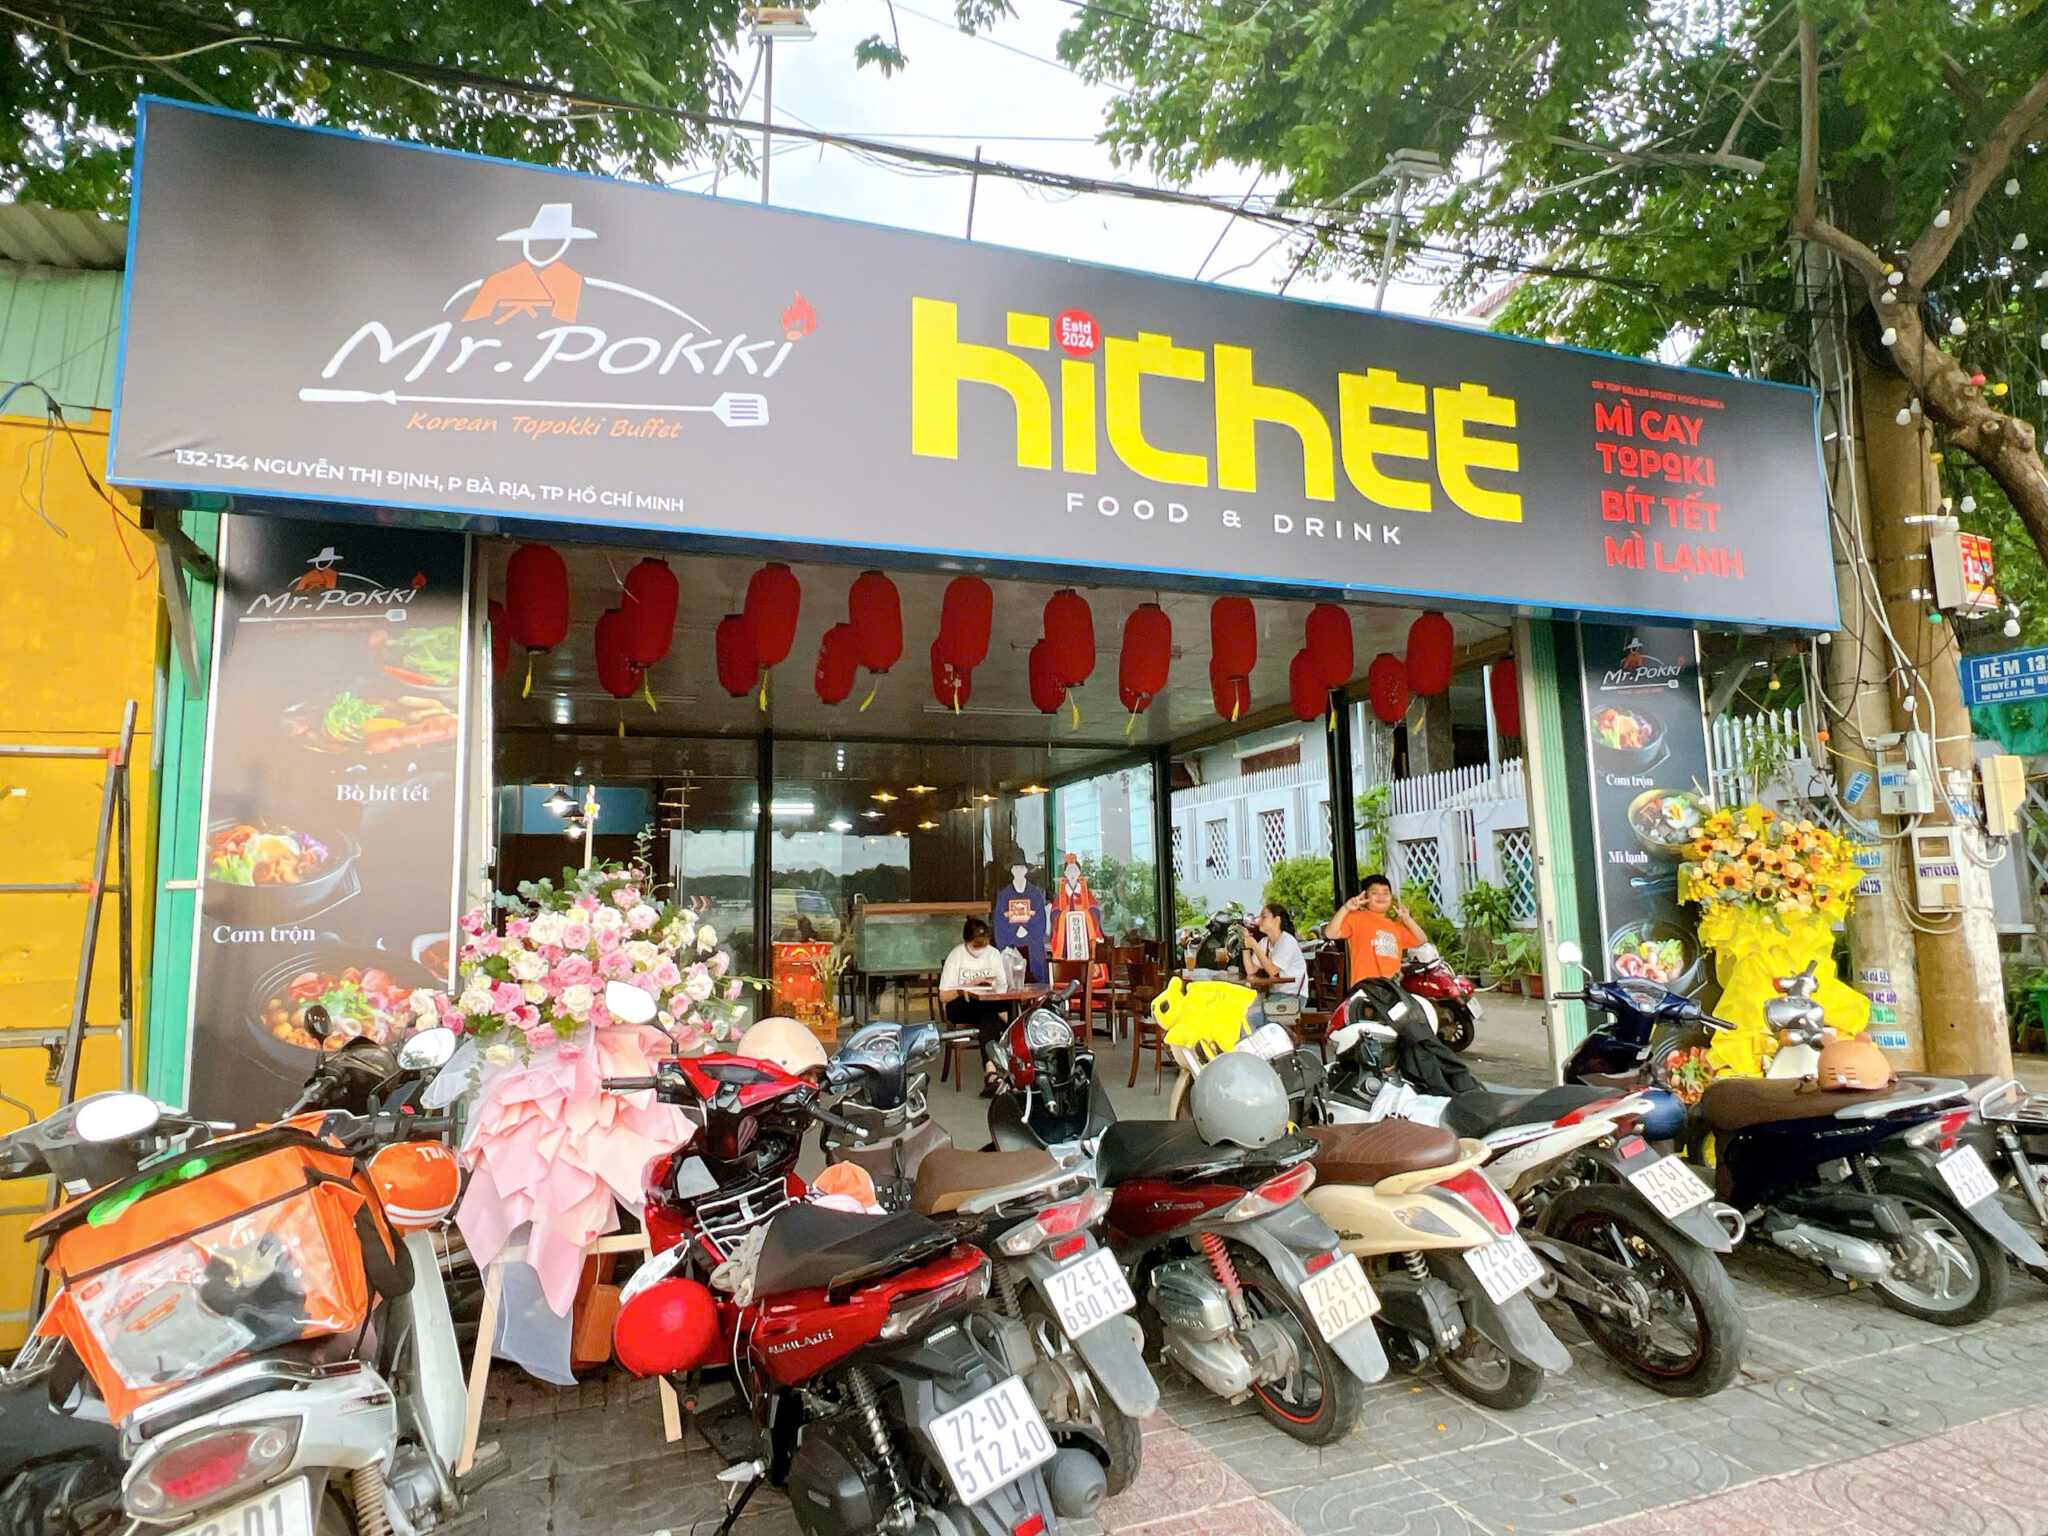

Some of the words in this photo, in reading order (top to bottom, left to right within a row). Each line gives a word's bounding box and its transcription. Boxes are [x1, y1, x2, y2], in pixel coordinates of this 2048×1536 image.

[1062, 316, 1092, 334] Estd
[1062, 331, 1094, 350] 2024
[406, 412, 498, 432] Korean
[511, 415, 606, 440] Topokki
[609, 418, 683, 439] Buffet
[1595, 398, 1633, 437] MÌ
[1640, 410, 1704, 446] CAY
[175, 449, 249, 471] 132-134
[254, 458, 344, 480] NGUYỄN
[349, 466, 382, 487] THỊ
[387, 470, 444, 492] ĐỊNH,
[448, 476, 462, 491] P
[467, 476, 494, 494] BÀ
[499, 482, 536, 500] RỊA,
[540, 485, 564, 500] TP
[568, 486, 597, 504] HỒ
[600, 490, 633, 508] CHÍ
[636, 495, 684, 512] MINH
[1066, 492, 1189, 523] FOOD
[1222, 510, 1242, 529] &
[1274, 514, 1401, 545] DRINK
[1601, 485, 1655, 525] BÍT
[1661, 491, 1720, 532] TẾT
[1604, 530, 1645, 569] MÌ
[1653, 541, 1744, 582] LẠNH
[1979, 657, 2020, 679] HẺM
[2027, 655, 2048, 673] 13
[337, 783, 365, 801] Bò
[402, 783, 431, 801] tết
[213, 925, 265, 944] Cơm
[270, 925, 316, 945] trộn
[1056, 1257, 1110, 1302] 72-E1
[1311, 1264, 1356, 1307] 72-E1
[1064, 1279, 1130, 1332] 690.15
[1318, 1285, 1372, 1335] 502.17
[927, 1325, 957, 1345] HONDA
[946, 1388, 1020, 1452] 72-D1
[954, 1421, 1047, 1494] 512.40
